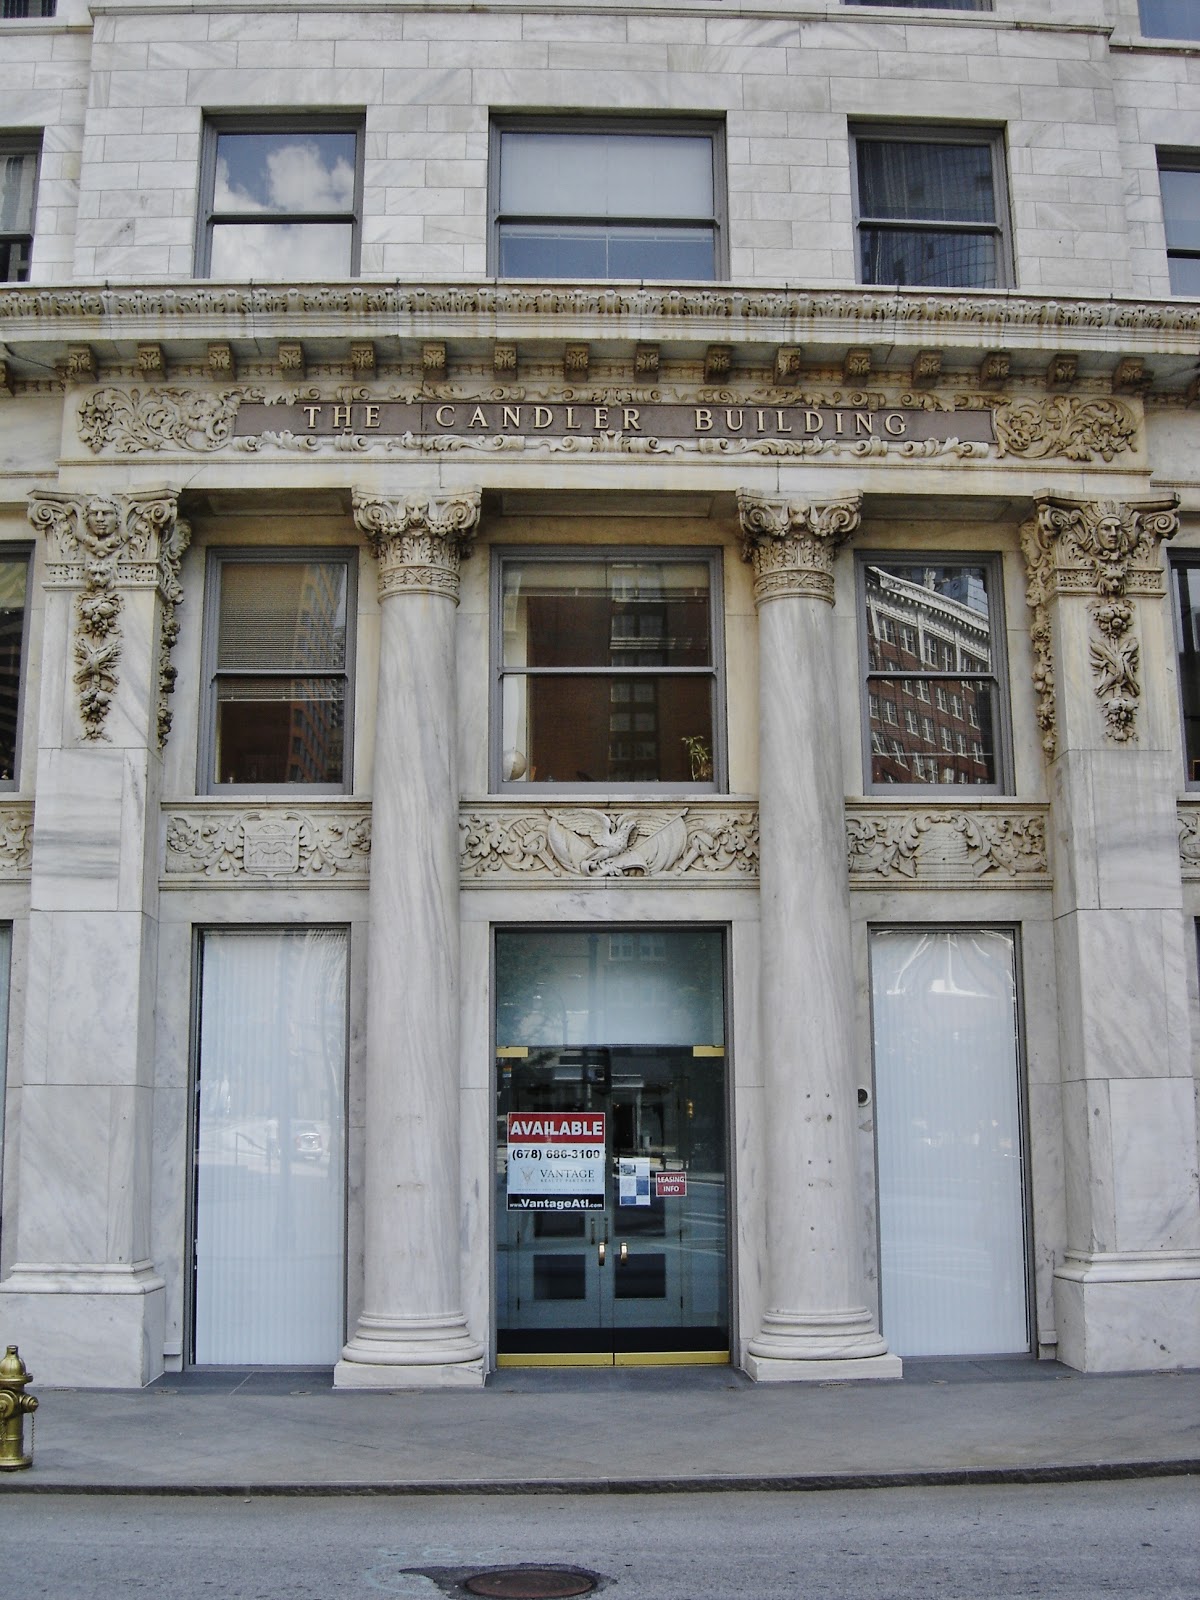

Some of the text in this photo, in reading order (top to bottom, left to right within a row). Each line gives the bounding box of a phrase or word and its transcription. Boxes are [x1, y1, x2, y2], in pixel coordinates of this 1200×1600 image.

[303, 405, 907, 435] THE CANDLER BUILDING
[510, 1121, 603, 1136] AVAILABLE
[512, 1149, 600, 1161] (678) 686-3100
[540, 1169, 595, 1179] VANTAGE
[509, 1198, 603, 1210] www.VantageAtl.com
